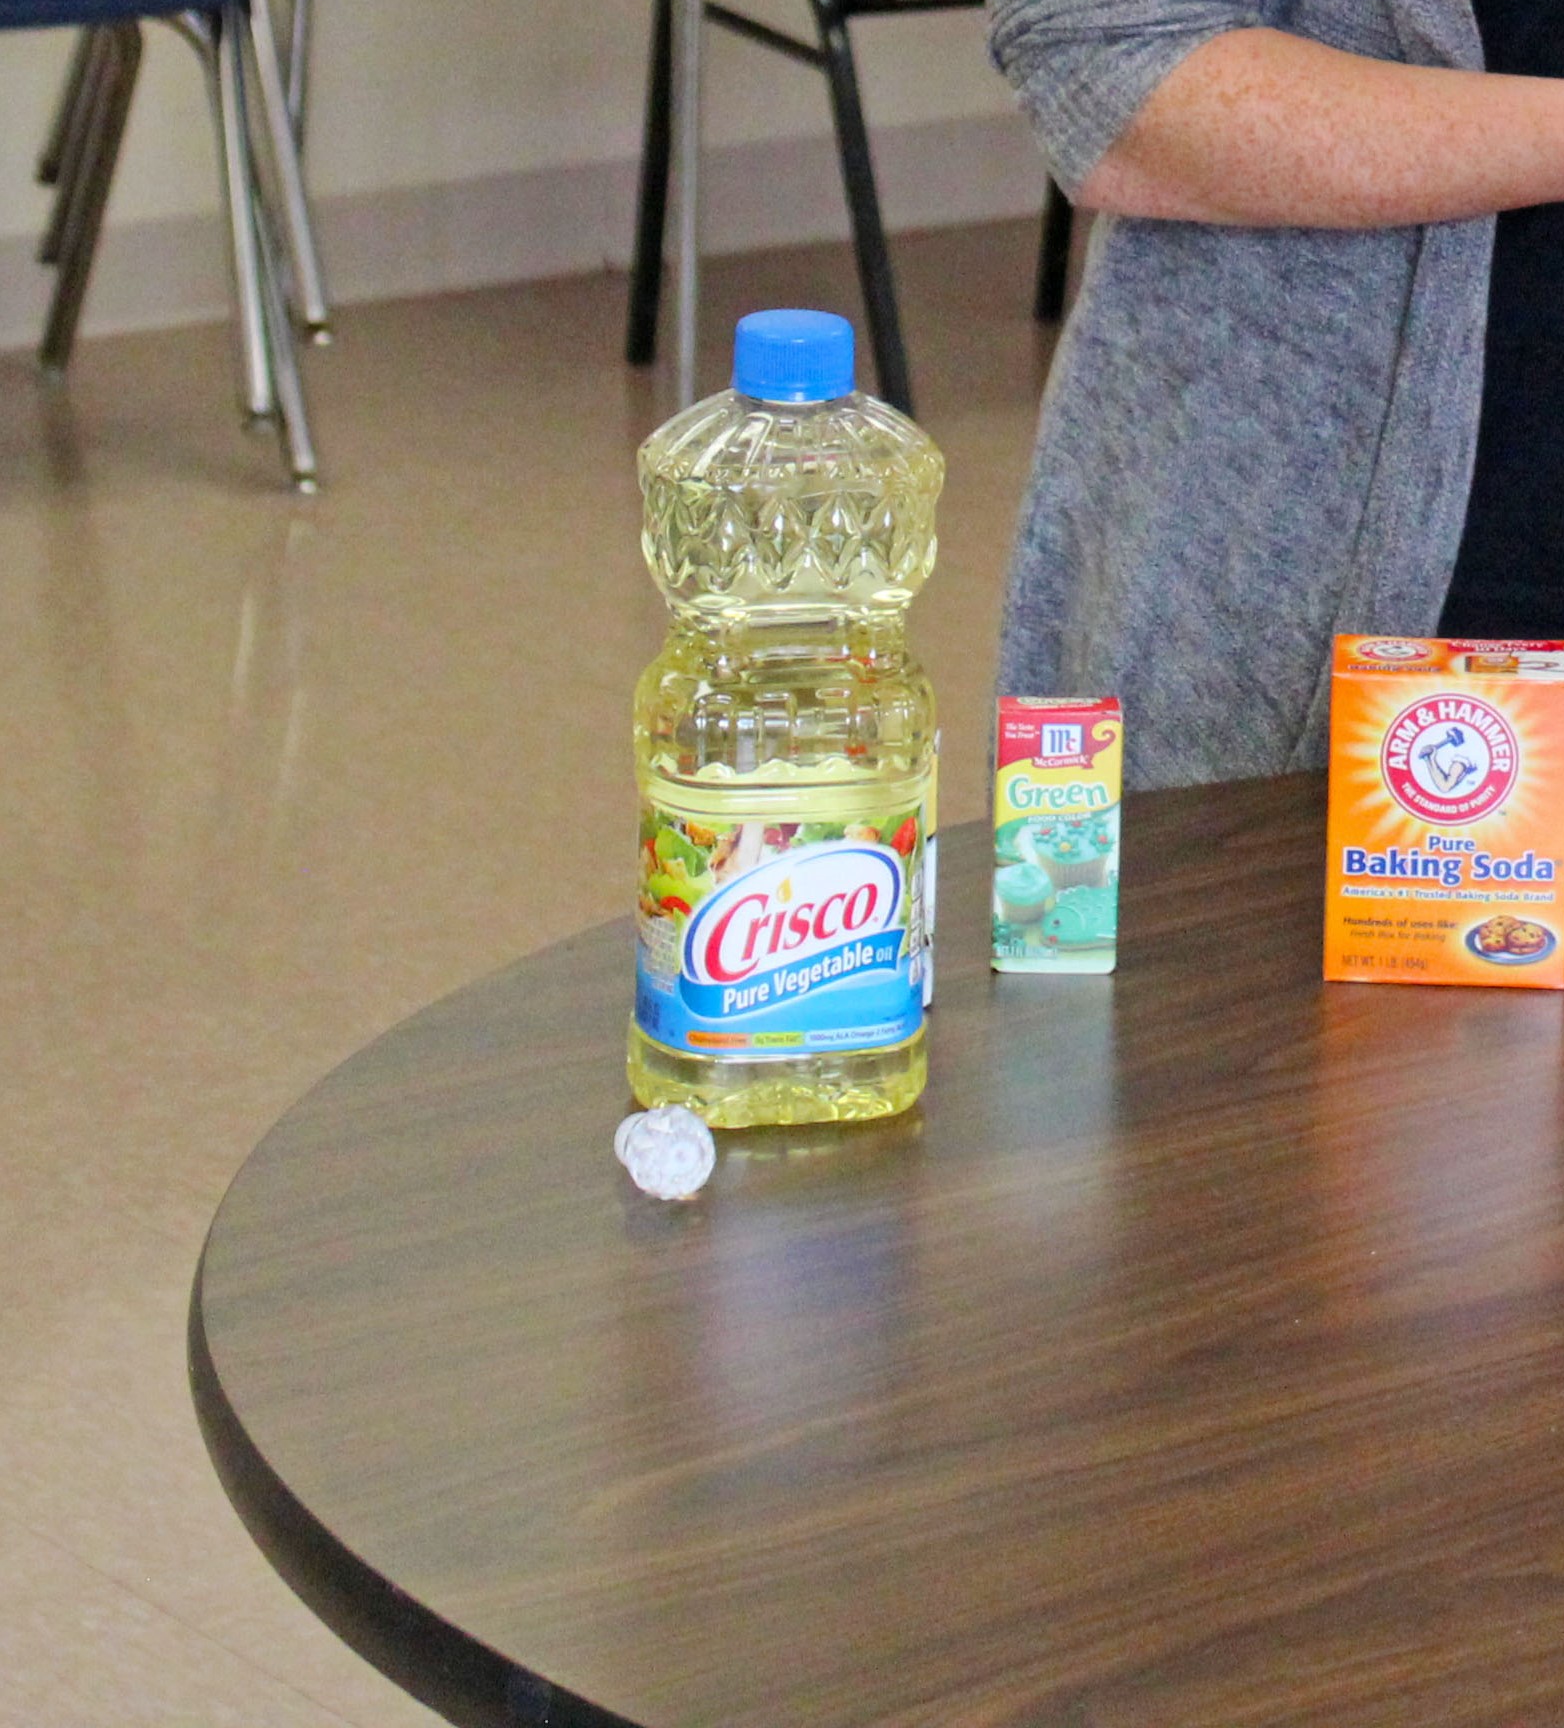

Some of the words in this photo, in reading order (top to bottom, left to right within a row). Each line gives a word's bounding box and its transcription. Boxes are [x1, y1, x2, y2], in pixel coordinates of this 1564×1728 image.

[1388, 718, 1421, 771] ARM
[1415, 707, 1438, 727] &
[1437, 701, 1512, 772] HAMMER
[1033, 755, 1087, 768] McCormick
[1007, 776, 1109, 810] Green
[1428, 835, 1475, 852] Pure
[1344, 848, 1462, 885] Baking
[1472, 852, 1554, 880] Soda
[1342, 886, 1393, 898] America's
[1415, 889, 1451, 899] Trusted
[1456, 891, 1491, 903] Baking
[1495, 892, 1519, 902] Soda
[1523, 893, 1554, 902] Brand
[704, 883, 878, 983] Crisco
[1343, 917, 1392, 928] Hundreds
[1396, 918, 1408, 928] of
[1411, 920, 1433, 928] uses
[723, 986, 770, 1014] Pure
[773, 944, 874, 996] Vegetable
